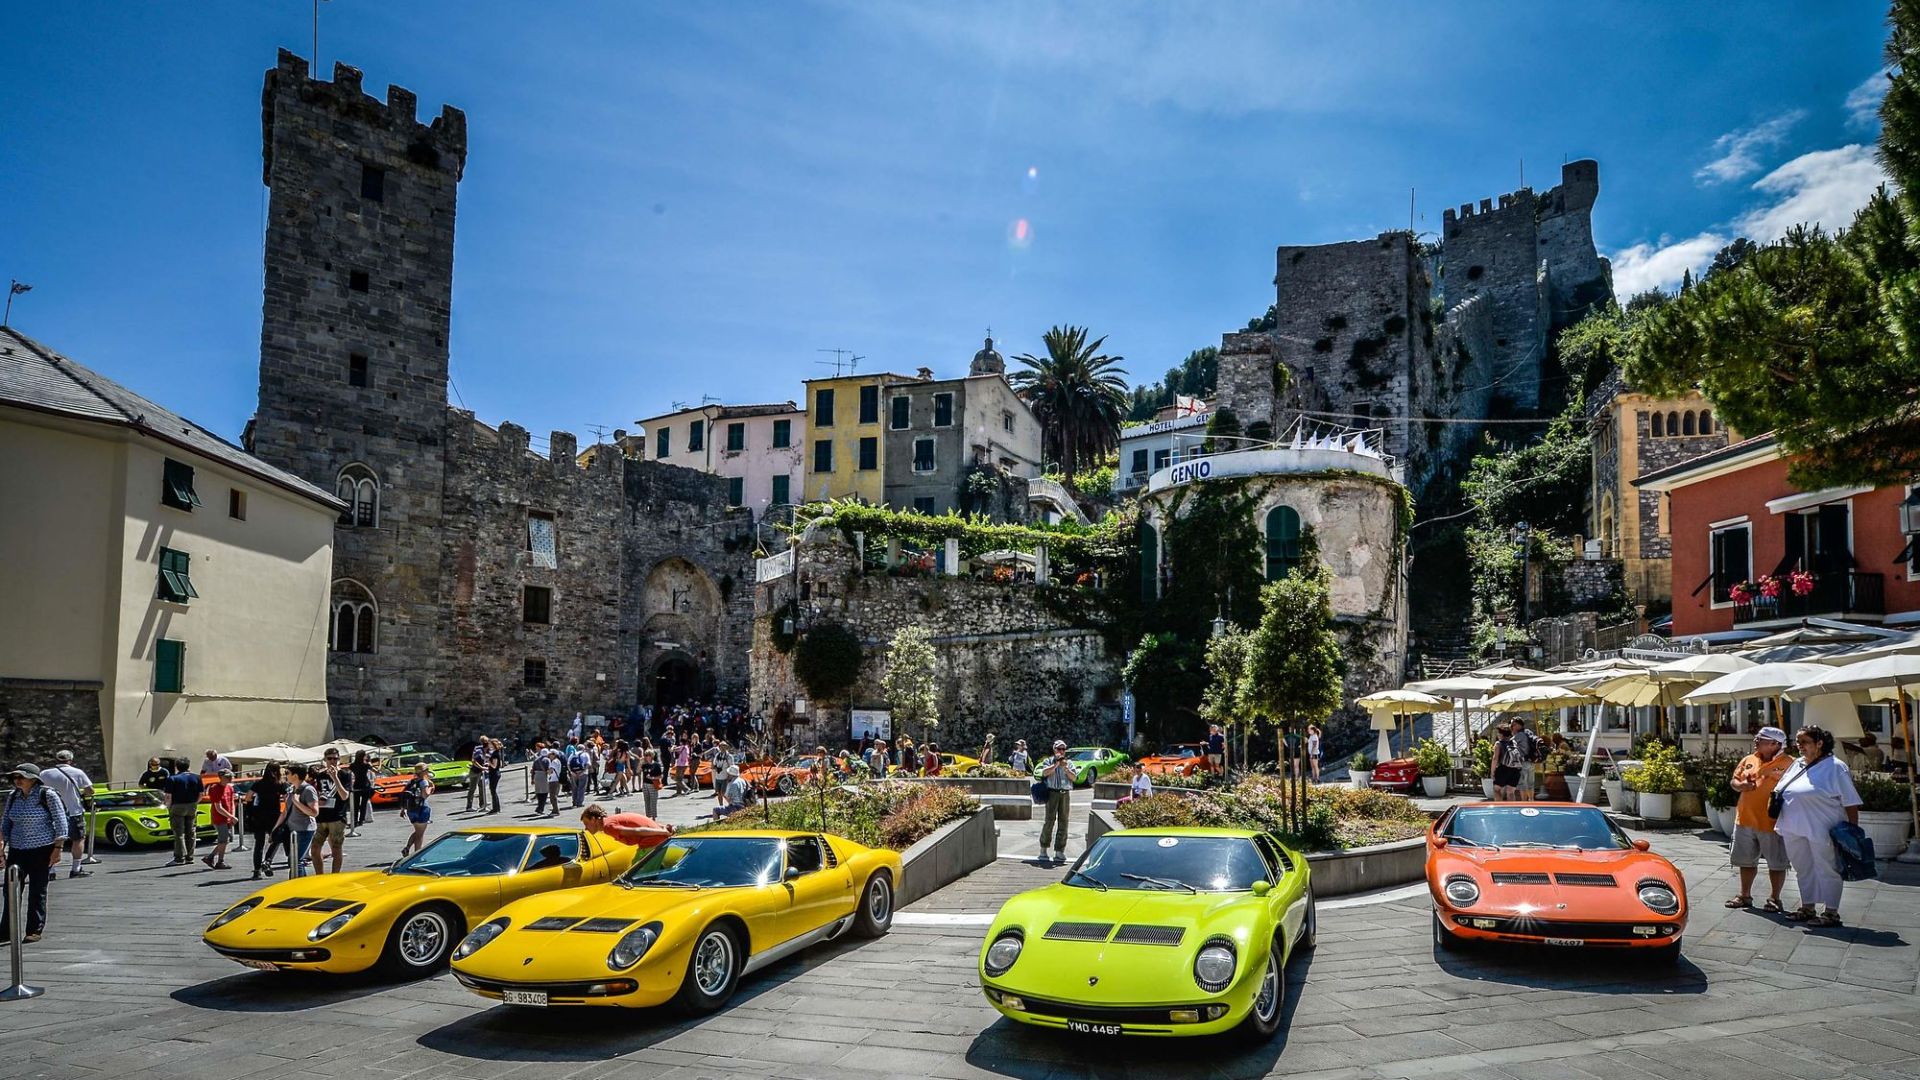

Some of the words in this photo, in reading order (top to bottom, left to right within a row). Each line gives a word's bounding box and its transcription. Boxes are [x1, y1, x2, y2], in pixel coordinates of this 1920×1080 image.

[1149, 421, 1172, 432] HOTEL
[1171, 461, 1211, 484] GENIO
[1092, 1025, 1121, 1035] 446F
